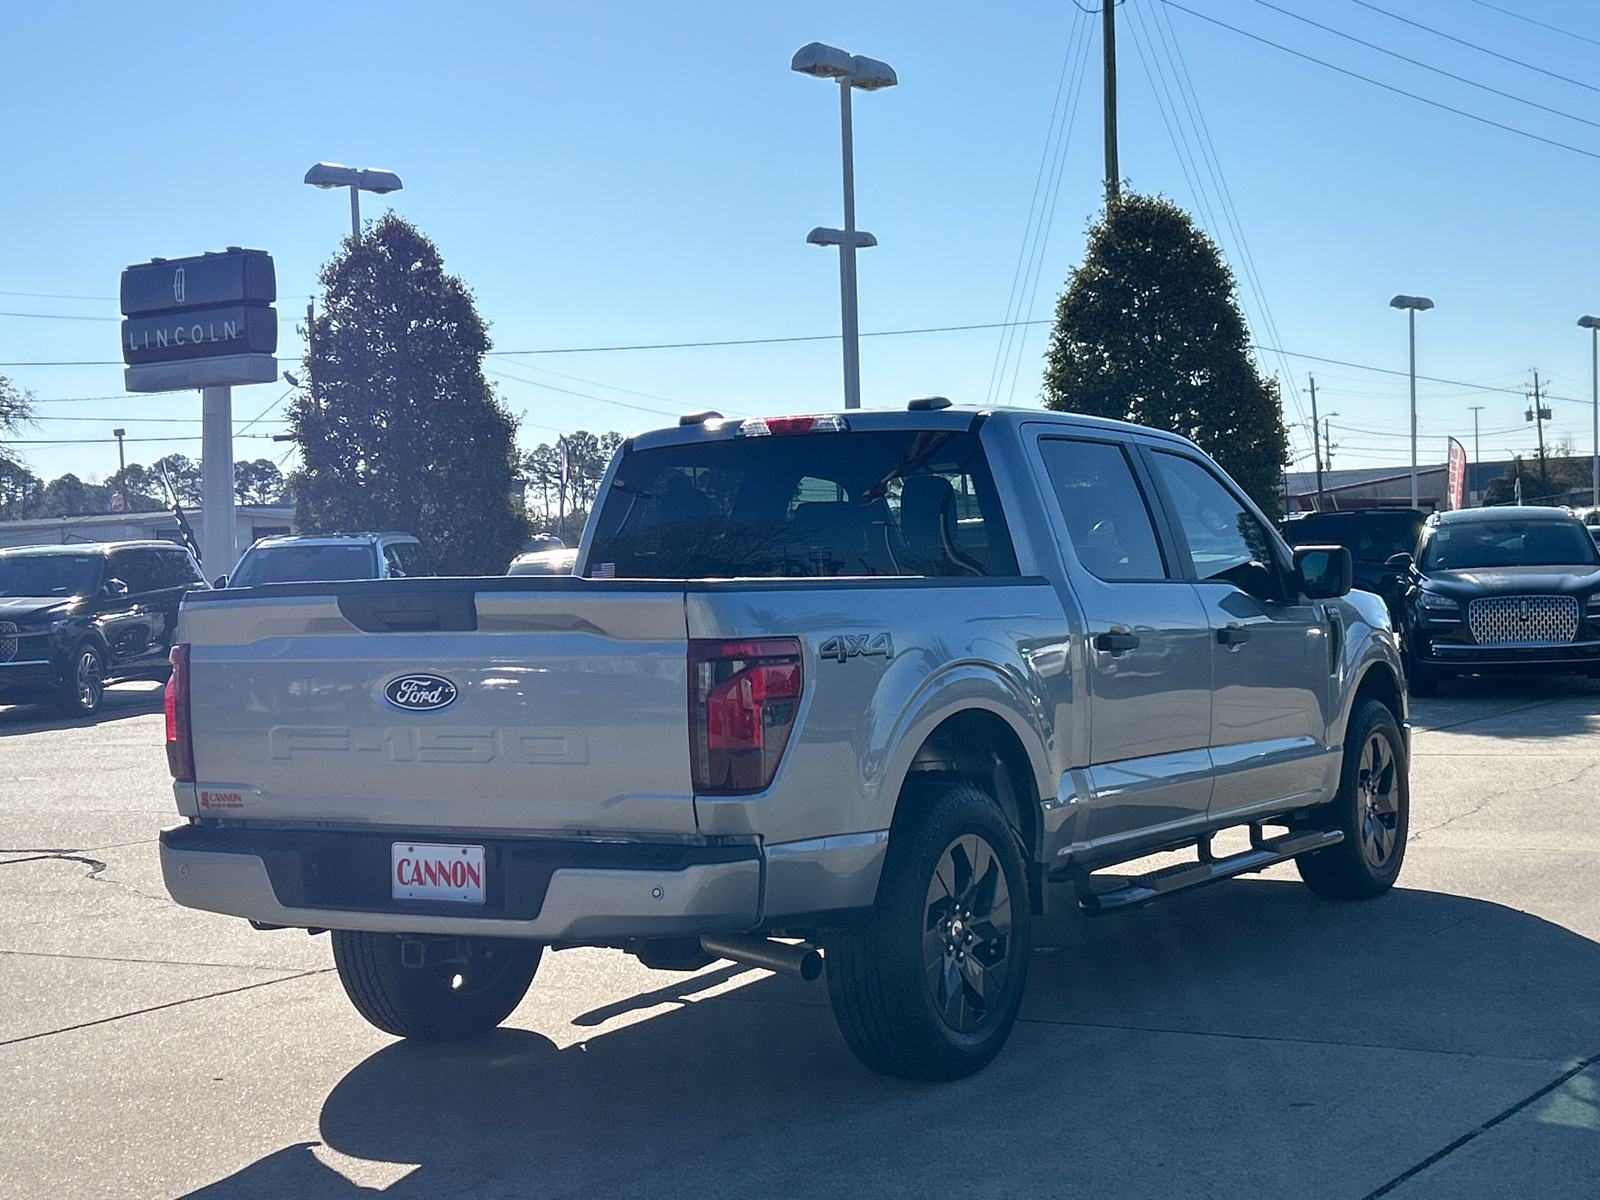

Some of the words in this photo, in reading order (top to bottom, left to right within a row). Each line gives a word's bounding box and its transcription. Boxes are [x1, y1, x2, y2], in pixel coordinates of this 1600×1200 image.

[129, 320, 237, 351] LINCOLN
[396, 680, 443, 704] Ford
[268, 724, 590, 765] F-150
[209, 792, 242, 803] CANNON
[396, 857, 480, 889] CANNON
